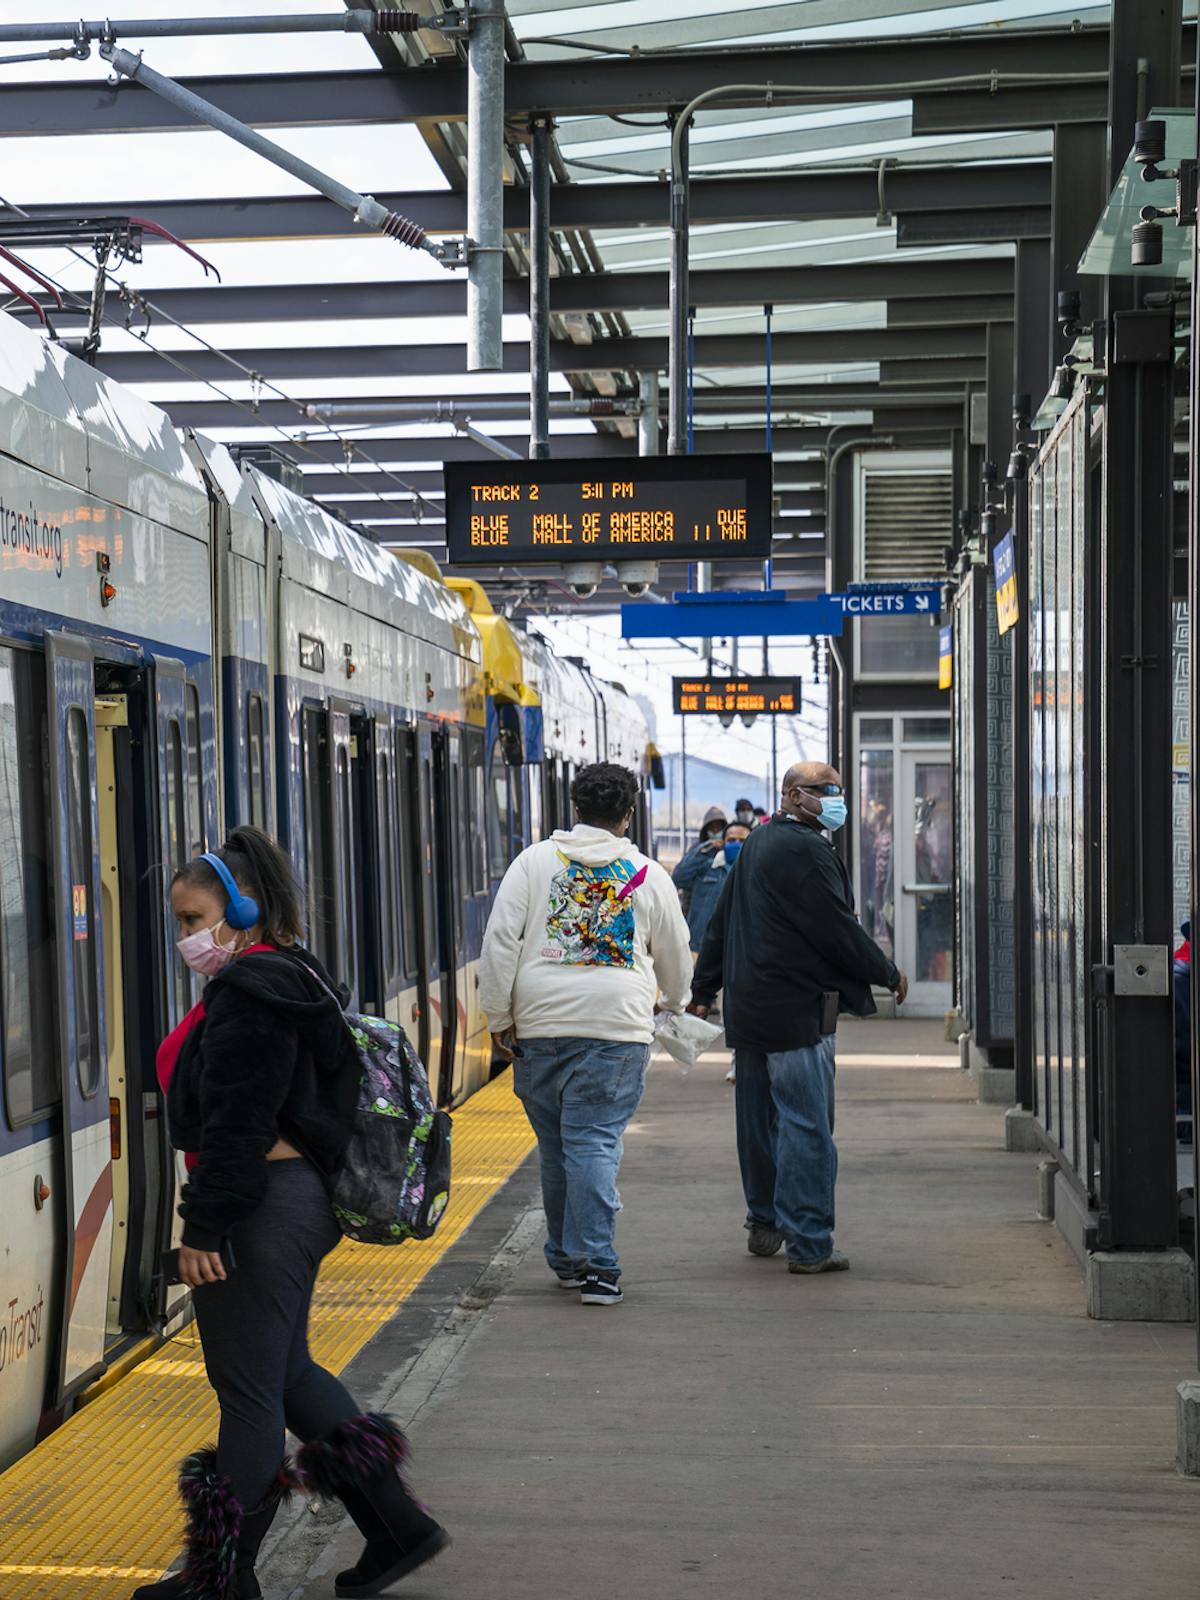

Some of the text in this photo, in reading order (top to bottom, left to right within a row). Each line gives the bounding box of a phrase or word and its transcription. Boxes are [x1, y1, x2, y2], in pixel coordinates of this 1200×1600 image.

[471, 482, 634, 501] TRACK 2 5:11 PM
[471, 509, 747, 530] BLUE MALL OF AMERICA DUE
[471, 530, 509, 546] BLUE
[533, 528, 573, 544] MALL
[582, 528, 601, 543] OF
[610, 526, 674, 542] AMERICA
[721, 524, 747, 540] MIN
